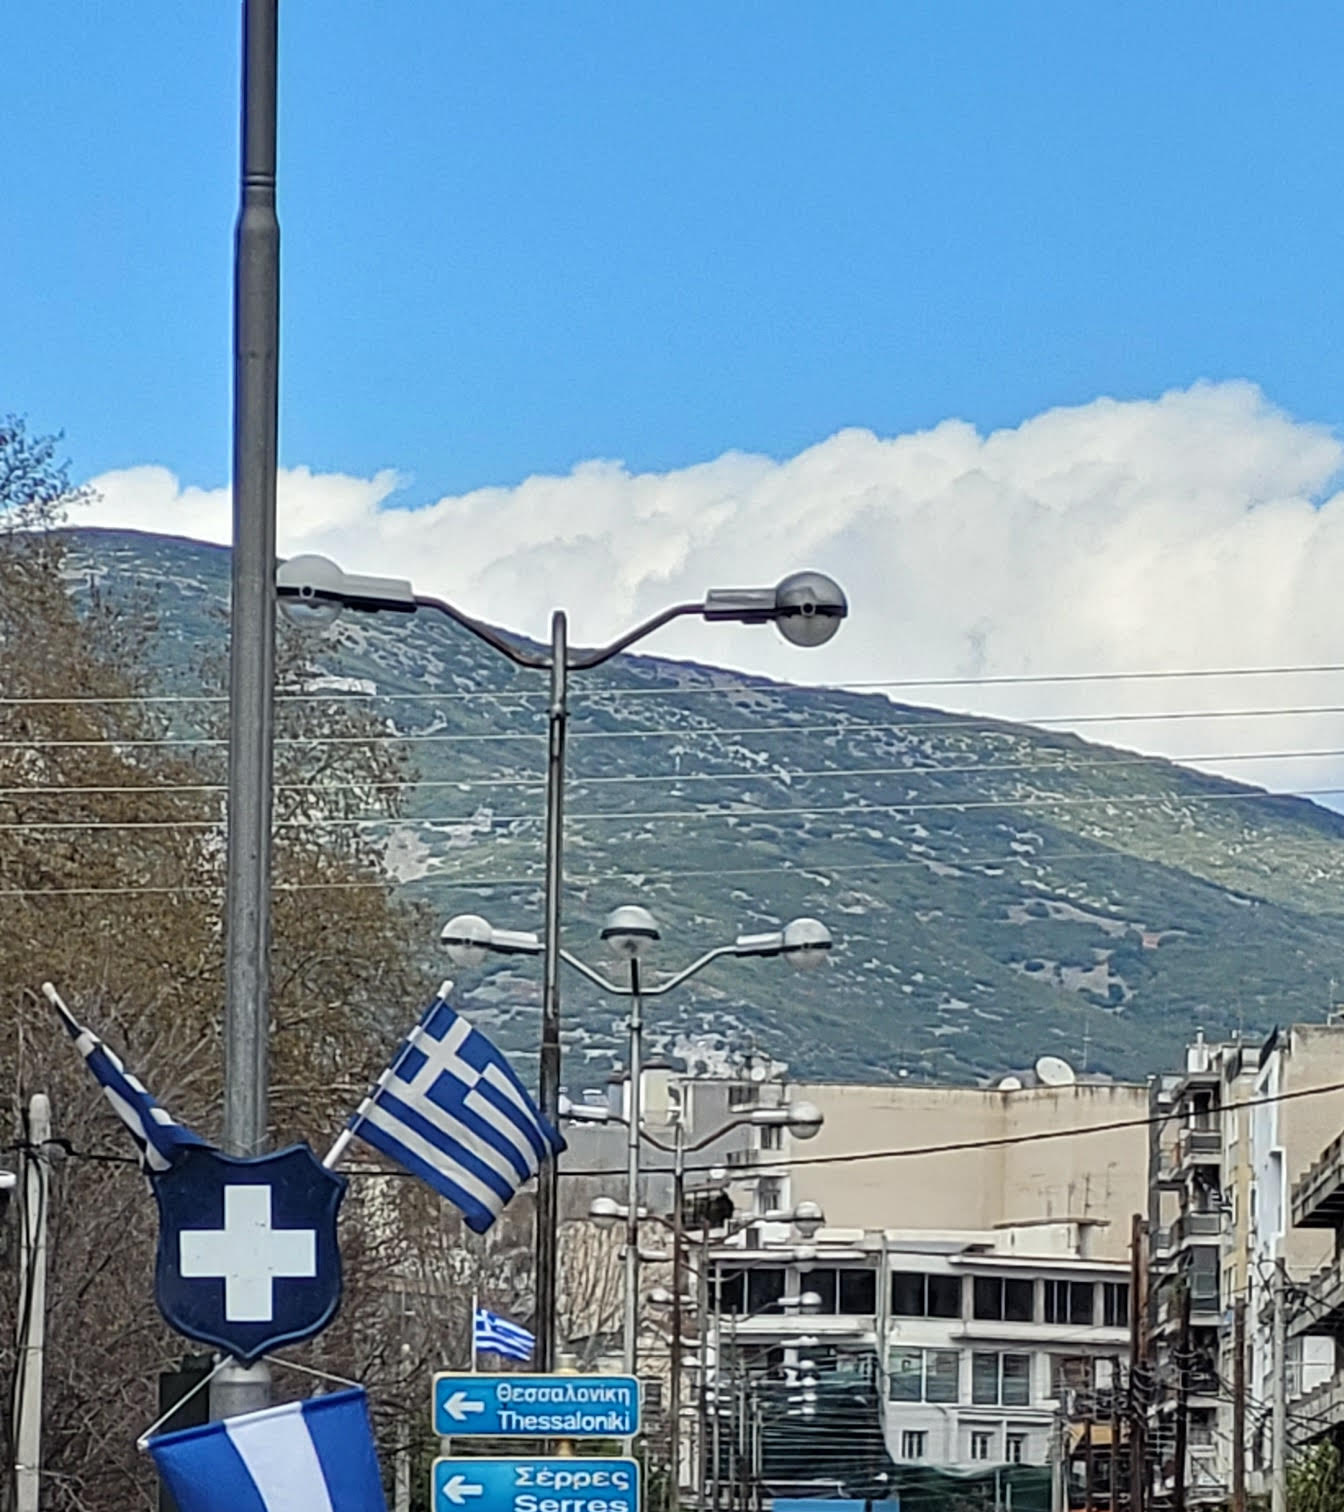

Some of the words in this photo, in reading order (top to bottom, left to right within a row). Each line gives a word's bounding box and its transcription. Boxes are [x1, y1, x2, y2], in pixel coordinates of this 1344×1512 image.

[496, 1383, 631, 1406] Θεσσαλονίκη
[496, 1410, 631, 1431] Thessaloniki
[514, 1466, 629, 1490] Σέρρες
